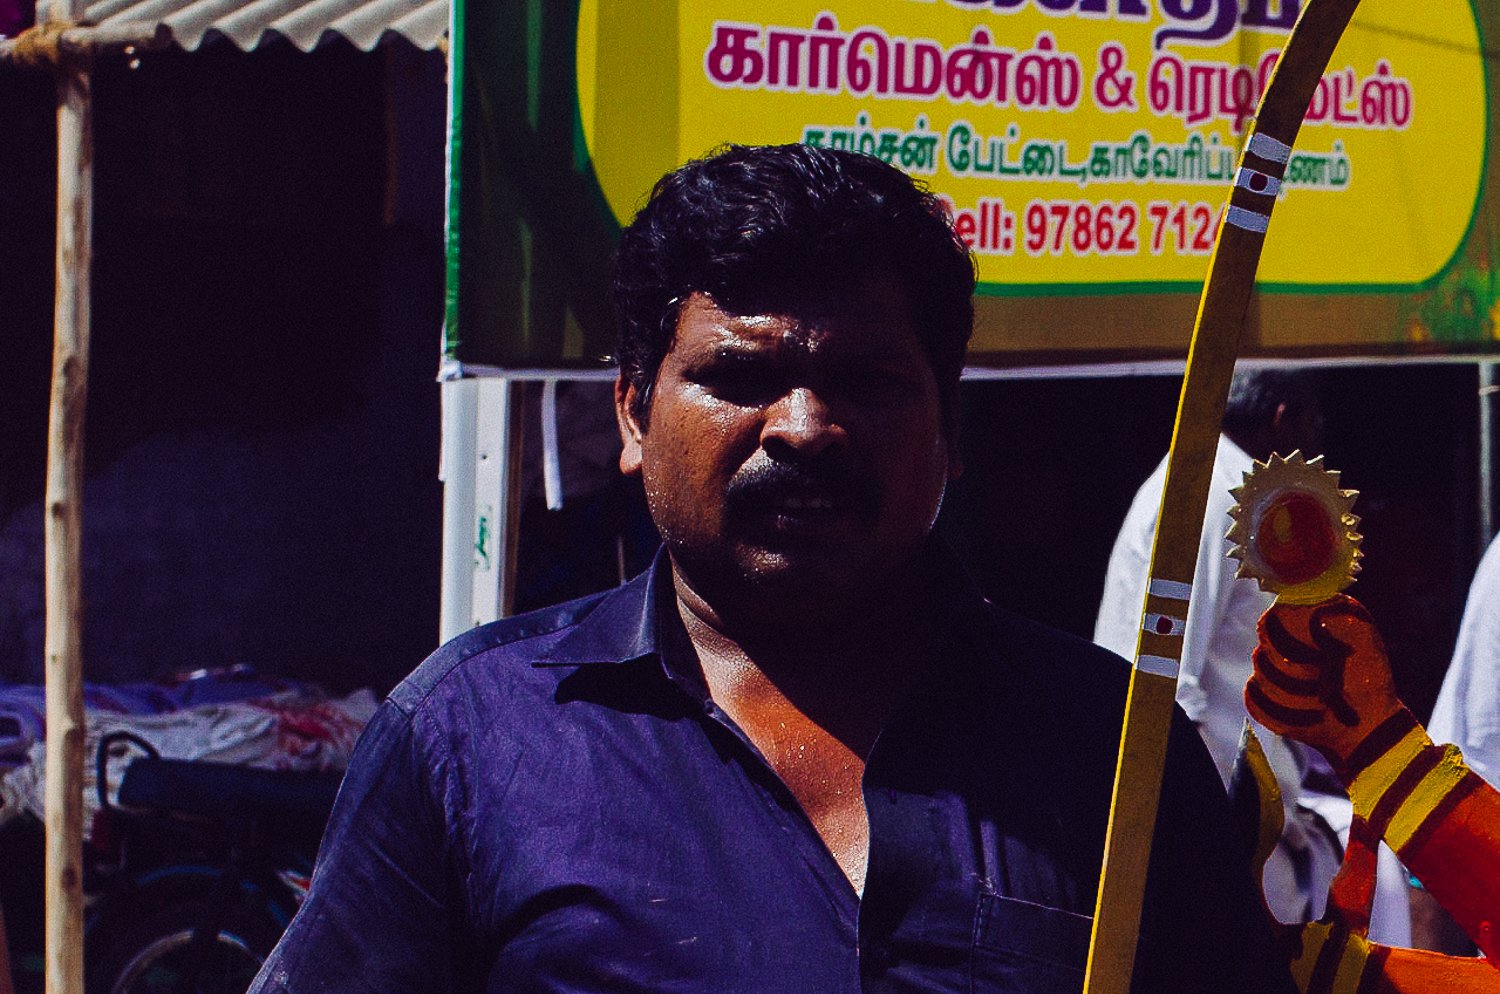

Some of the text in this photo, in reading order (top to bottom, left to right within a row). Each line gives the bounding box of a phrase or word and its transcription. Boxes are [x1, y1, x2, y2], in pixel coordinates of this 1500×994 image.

[707, 15, 1080, 107] கார்மென்ஸ்
[1095, 46, 1134, 109] &
[1149, 51, 1410, 133] ரெடிட்ஸ்
[938, 199, 1223, 251] ell: 97862 712
